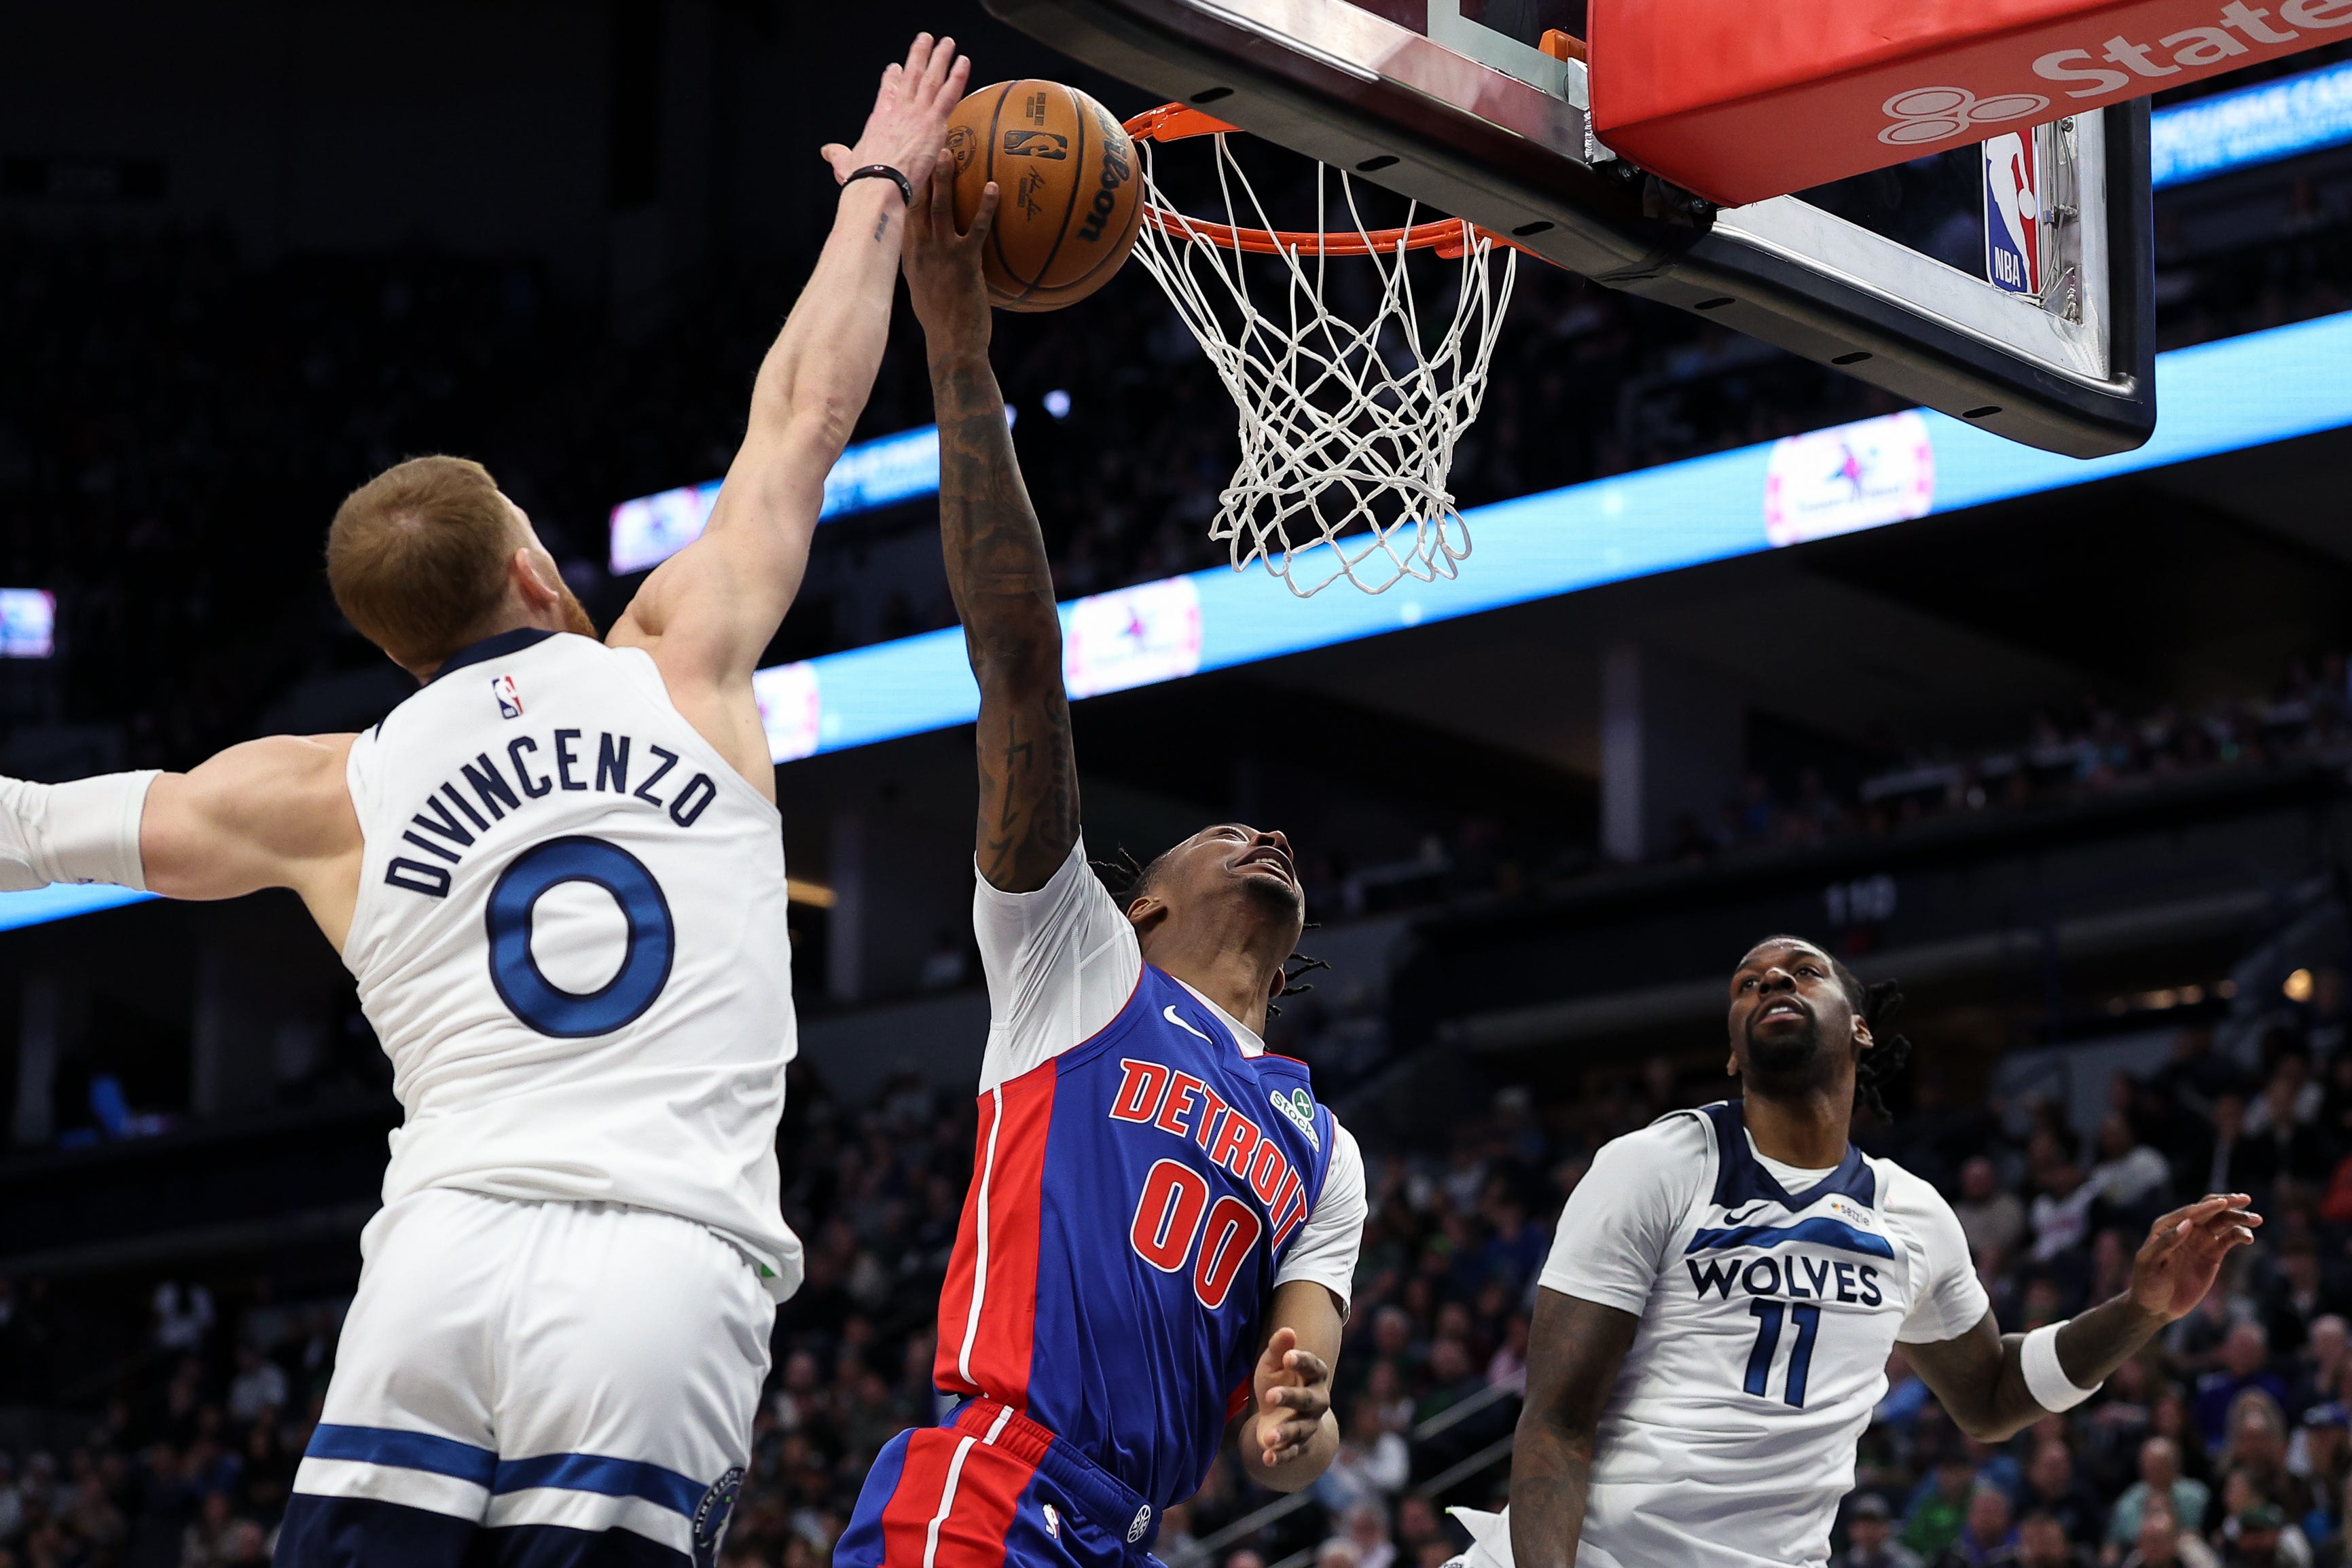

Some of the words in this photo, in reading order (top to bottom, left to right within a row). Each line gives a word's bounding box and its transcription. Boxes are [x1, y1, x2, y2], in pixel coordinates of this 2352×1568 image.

[2032, 0, 2352, 98] State
[1994, 246, 2022, 289] NBA
[384, 729, 717, 898] DIVINCENZO
[485, 835, 675, 1039] 0
[1108, 1057, 1308, 1255] DETROIT
[1130, 1159, 1262, 1310] 00
[1841, 1204, 1870, 1226] sezzle
[1686, 1255, 1883, 1307] WOLVES
[1742, 1296, 1822, 1409] 11
